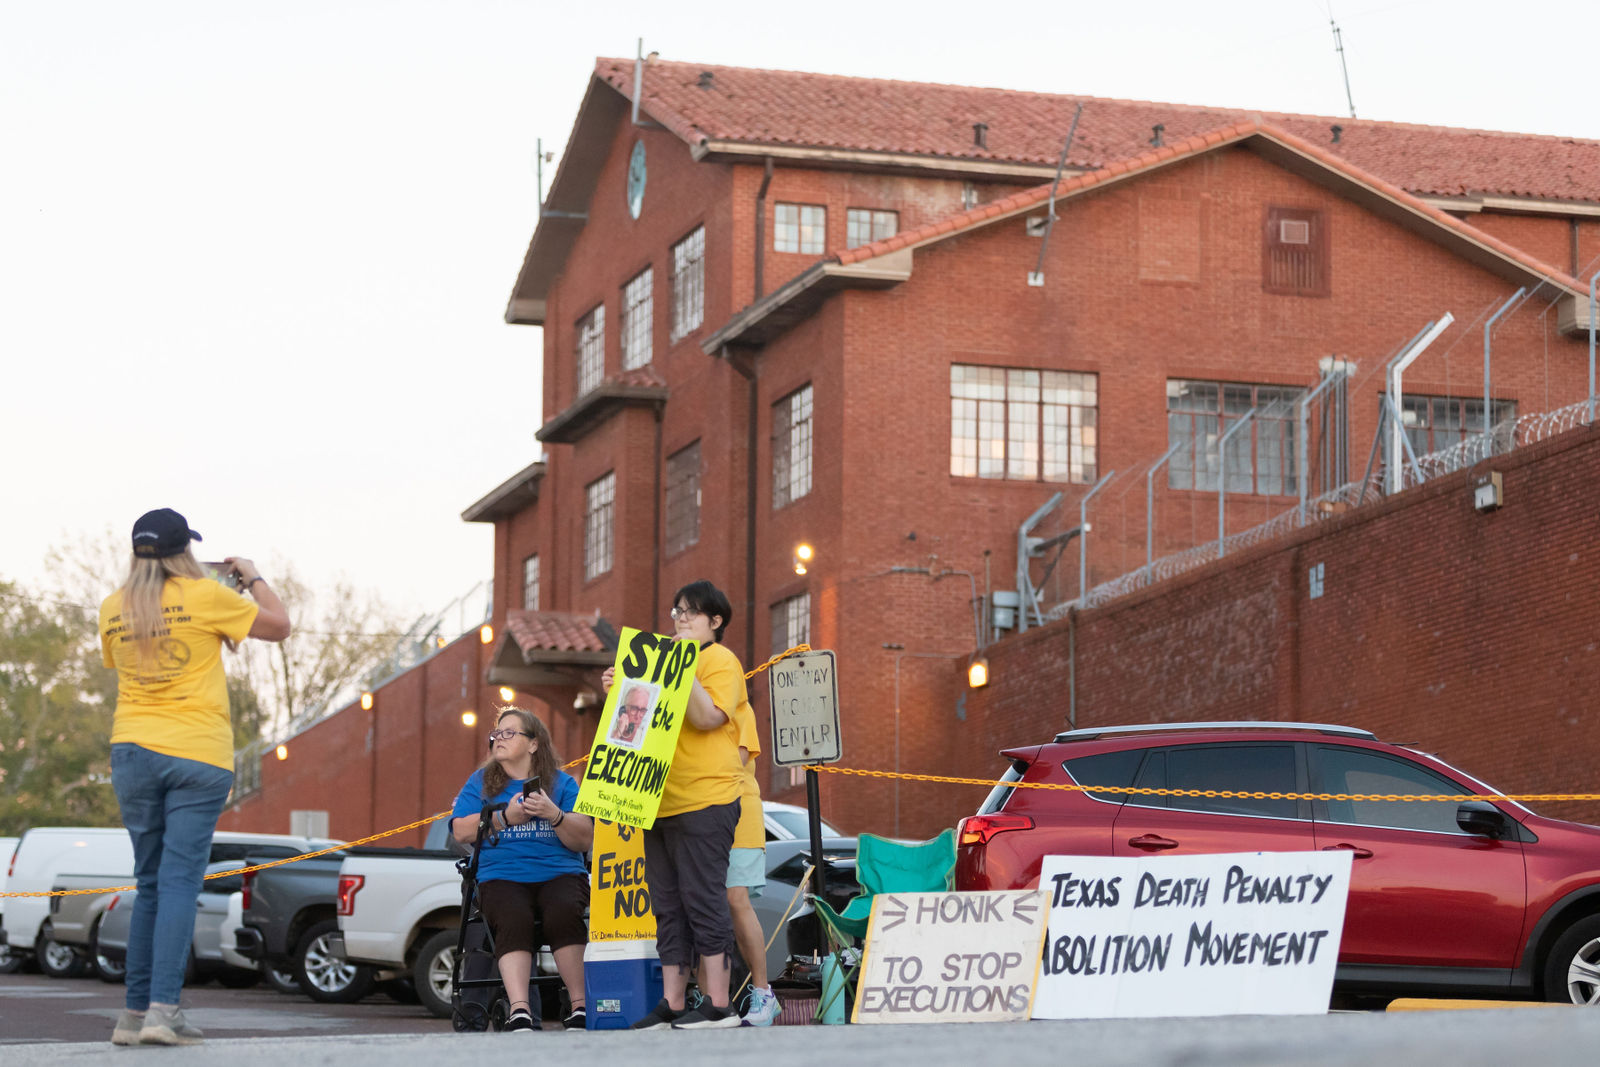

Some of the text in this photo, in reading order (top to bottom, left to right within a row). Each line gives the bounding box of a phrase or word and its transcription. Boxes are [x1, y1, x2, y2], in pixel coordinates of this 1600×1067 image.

[622, 631, 696, 692] STOP
[651, 700, 674, 731] the
[586, 744, 670, 798] EXECUTION!
[508, 820, 553, 832] RISON SH
[577, 801, 647, 826] ABOLITION MOVEMENT
[598, 852, 648, 890] EXEC
[614, 888, 656, 919] NO
[1051, 865, 1333, 910] TEXAS DEATH PENALTY
[916, 894, 1007, 925] HONK
[1184, 920, 1329, 968] MOVEMENT
[883, 951, 1023, 985] TO STOP
[860, 983, 1031, 1013] EXECUTIONS
